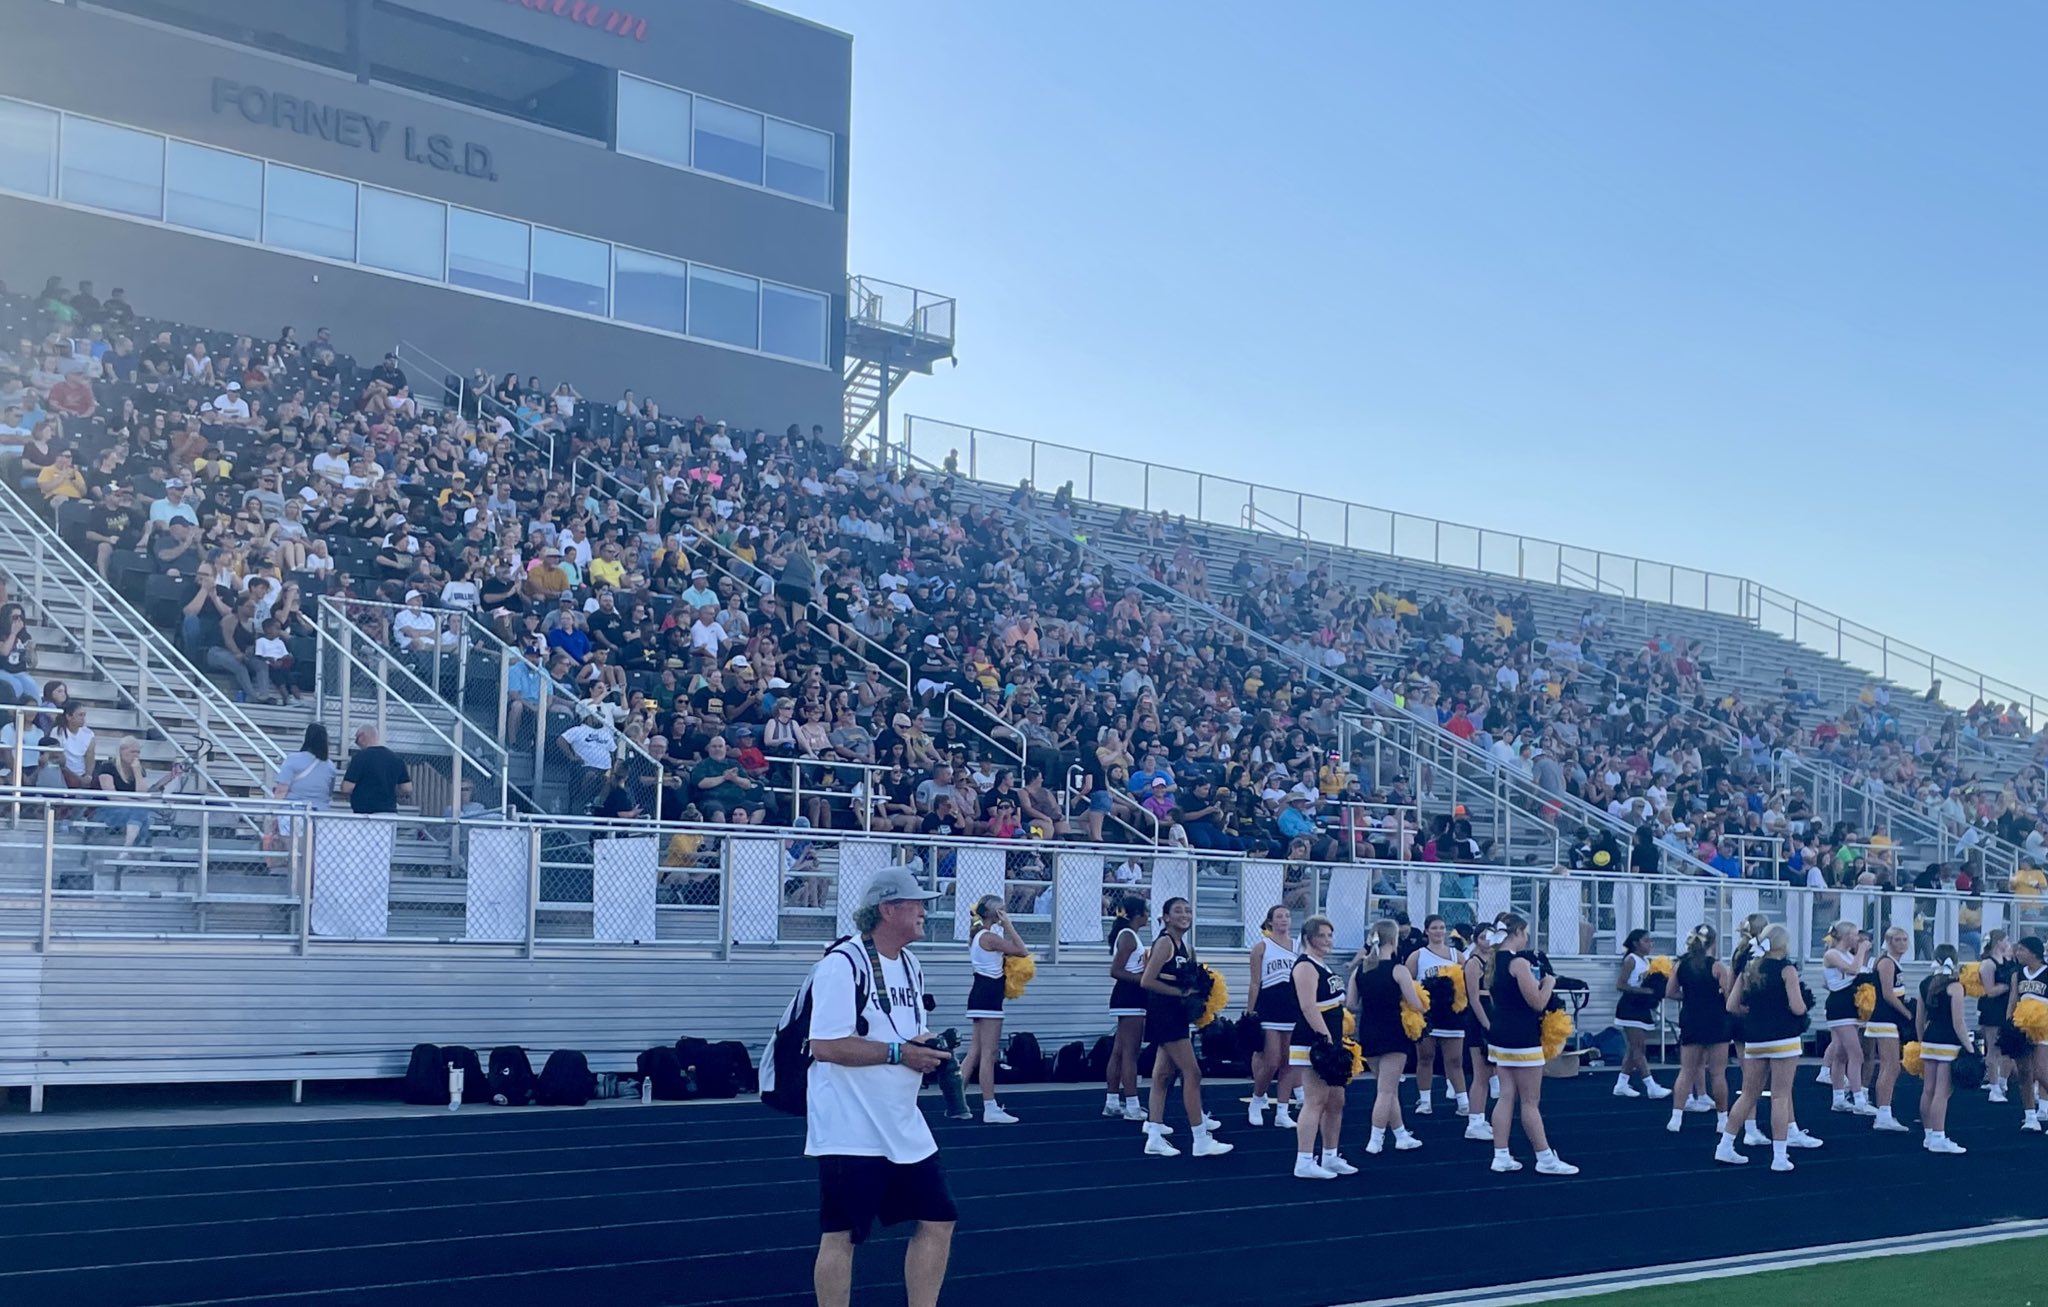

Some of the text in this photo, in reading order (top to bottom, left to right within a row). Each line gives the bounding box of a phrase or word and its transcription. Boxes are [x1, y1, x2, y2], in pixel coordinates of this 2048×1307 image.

[210, 76, 499, 182] FORNEY I.S.D.
[1266, 958, 1293, 975] FORNE
